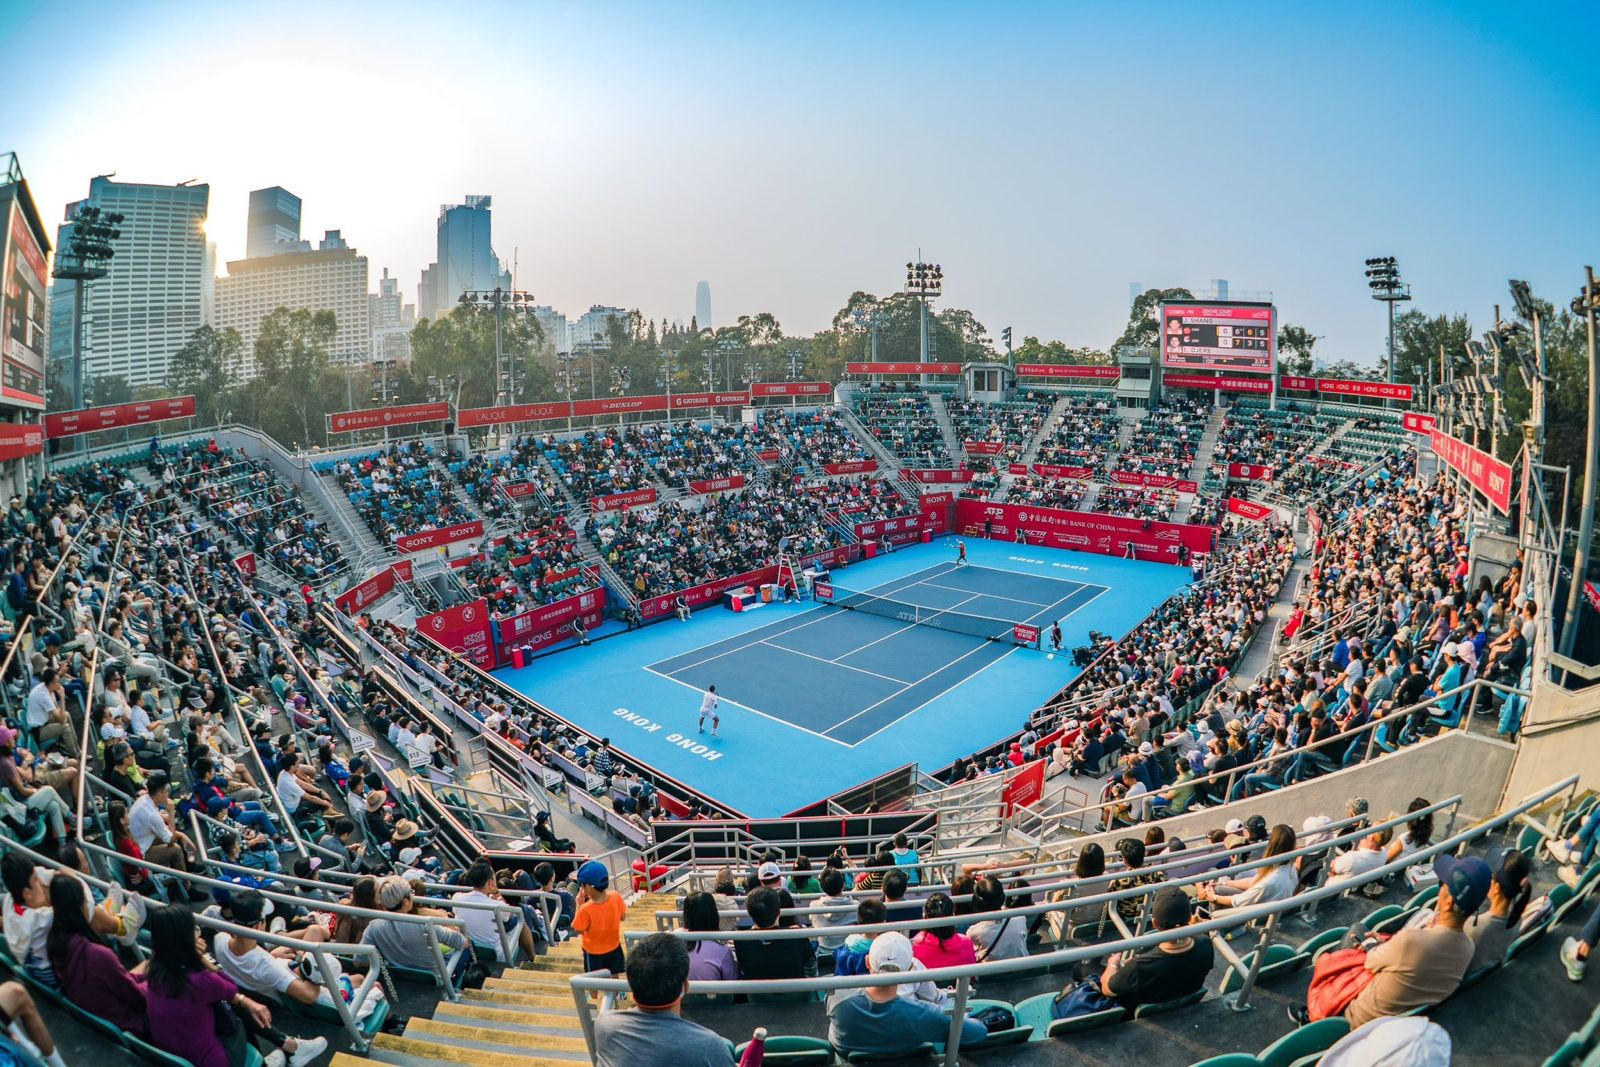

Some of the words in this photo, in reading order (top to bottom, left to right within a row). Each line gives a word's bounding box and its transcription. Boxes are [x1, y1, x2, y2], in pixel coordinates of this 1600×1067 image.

[609, 401, 643, 409] DUNLOP
[476, 410, 507, 421] LALIQUE
[525, 406, 554, 417] LALIQUE
[1488, 470, 1505, 496] SONY
[926, 495, 947, 504] SONY
[984, 507, 1004, 515] ATP
[449, 526, 476, 538] SONY
[1096, 524, 1116, 532] CHINA
[406, 535, 434, 548] SONY
[1009, 556, 1045, 564] KONG
[1052, 562, 1089, 571] HONG
[896, 611, 915, 621] ATP
[528, 631, 552, 645] HONG
[612, 708, 662, 733] KONG
[352, 735, 363, 744] S13
[665, 733, 724, 761] HONG
[409, 751, 420, 759] S13
